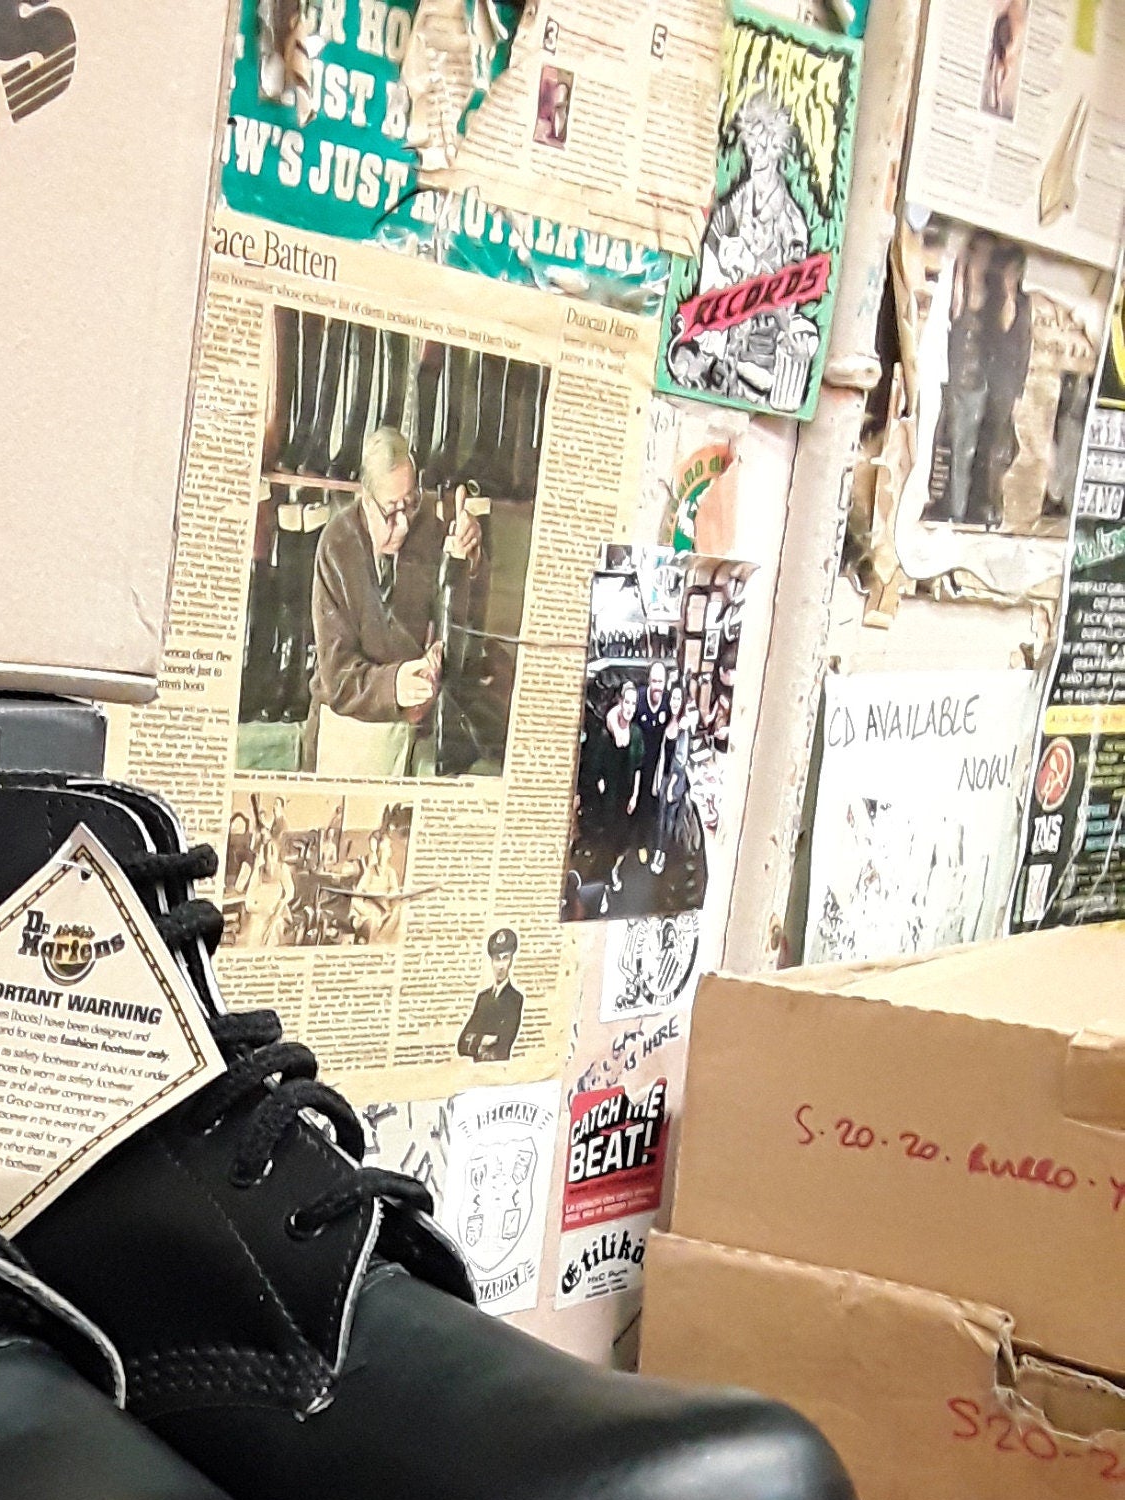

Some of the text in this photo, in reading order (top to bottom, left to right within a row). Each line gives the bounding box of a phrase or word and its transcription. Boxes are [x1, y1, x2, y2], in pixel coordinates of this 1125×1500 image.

[308, 140, 410, 216] JUST
[211, 226, 338, 282] ace Batten
[693, 262, 825, 329] RECORDS
[827, 694, 980, 748] CD AVAILABLE
[957, 744, 1018, 792] NOW!
[17, 932, 126, 961] Martens
[67, 993, 163, 1025] WARNING
[476, 1102, 539, 1131] BELGIAN
[570, 1093, 623, 1147] CATCH
[568, 1119, 654, 1183] BEAT!
[477, 1272, 521, 1302] TARDS
